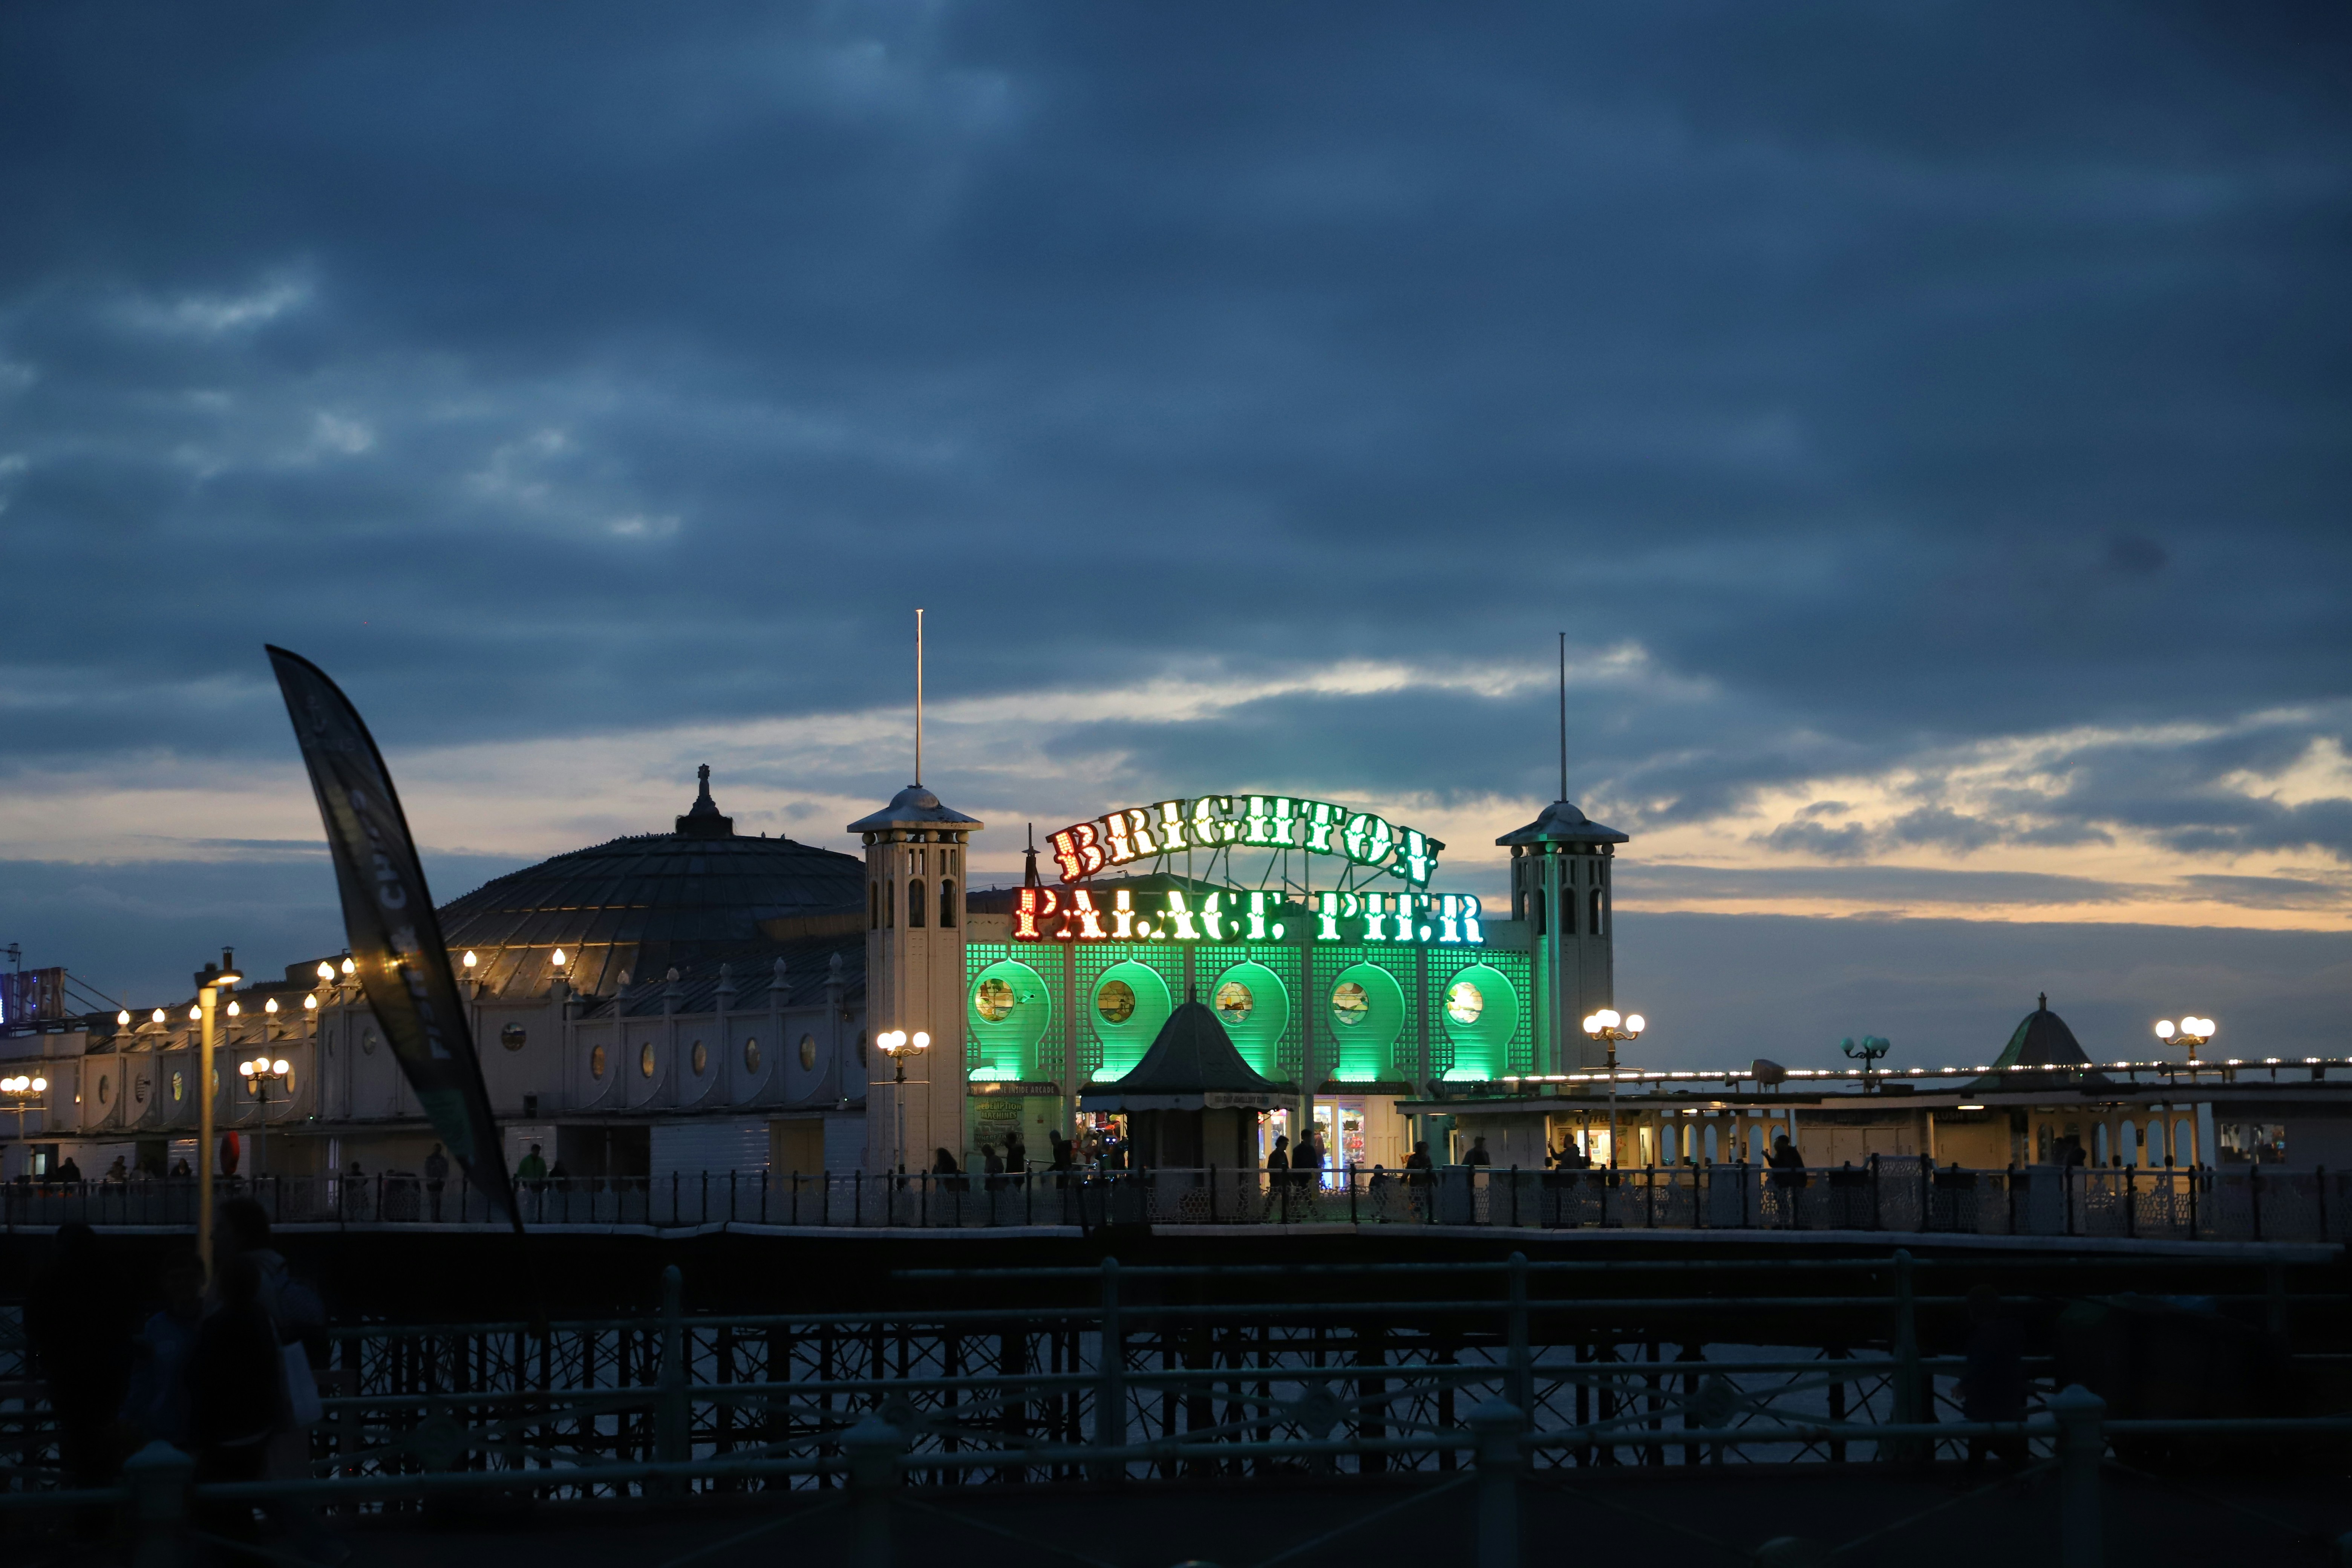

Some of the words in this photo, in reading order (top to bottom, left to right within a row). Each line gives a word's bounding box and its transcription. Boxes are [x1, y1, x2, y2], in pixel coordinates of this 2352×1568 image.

[1046, 794, 1446, 889] BRIGHTON
[1012, 887, 1286, 943] PALACE
[1315, 890, 1486, 947] PIER
[976, 1101, 1022, 1111] REDEMPTION
[981, 1111, 1017, 1120] MACHINES
[1934, 1111, 1964, 1121] LUSH
